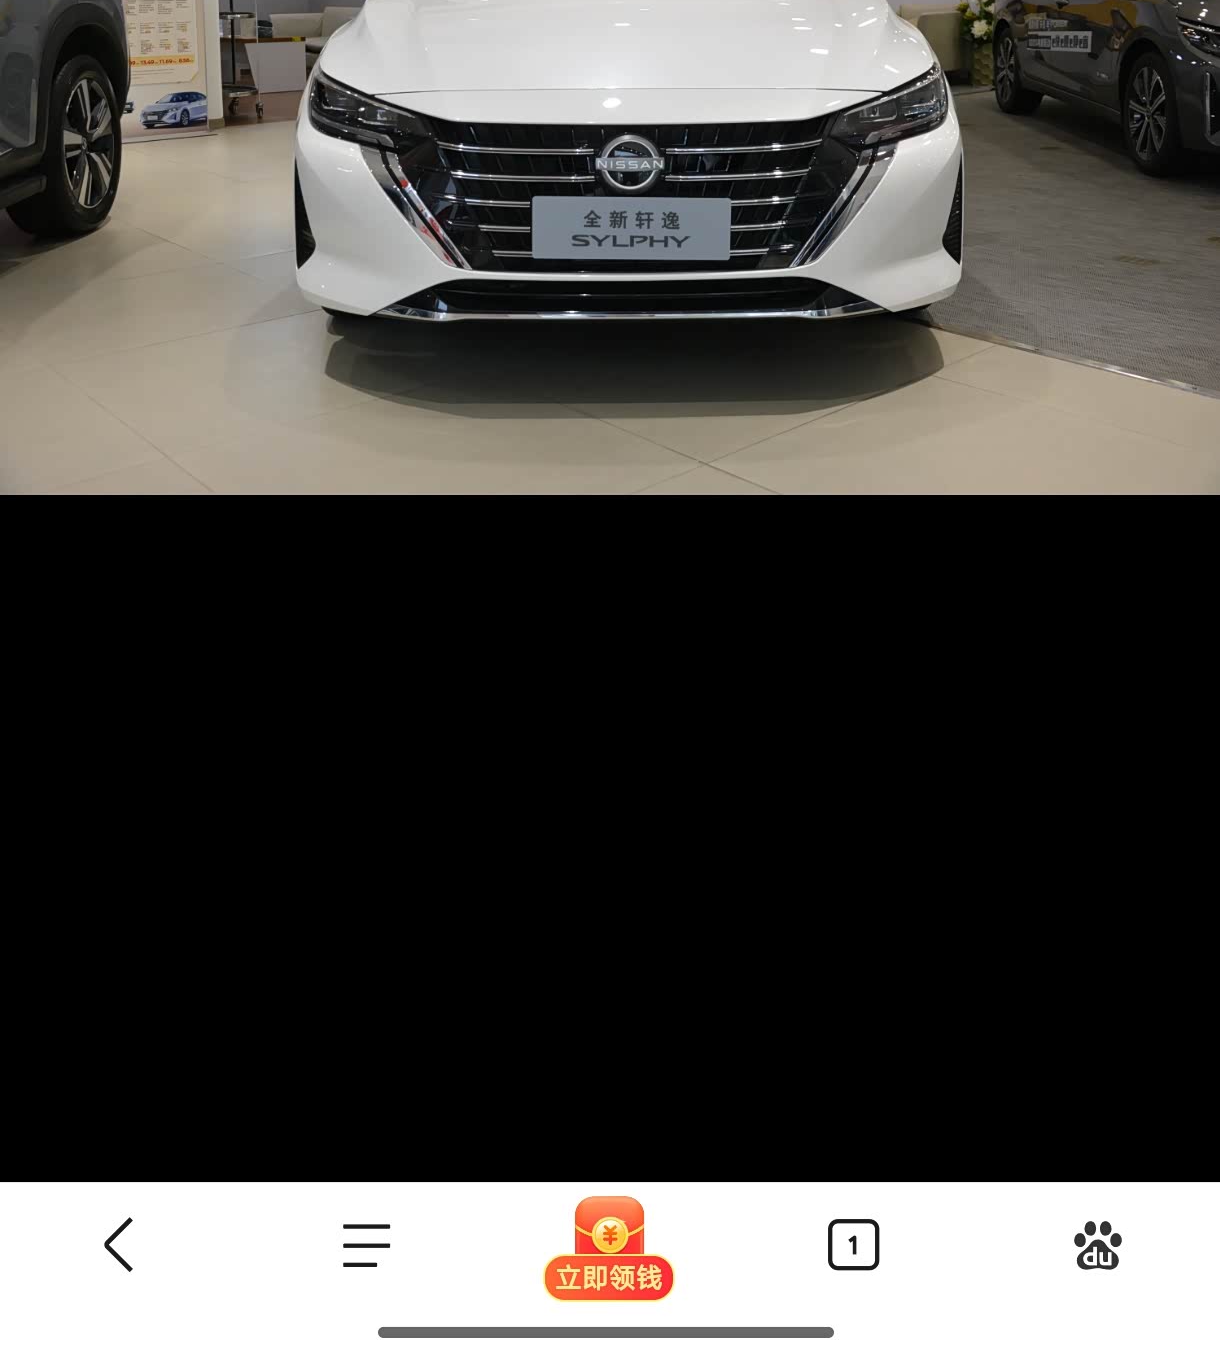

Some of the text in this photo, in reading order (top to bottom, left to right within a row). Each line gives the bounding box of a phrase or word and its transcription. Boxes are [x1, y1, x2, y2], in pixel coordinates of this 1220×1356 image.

[597, 159, 664, 169] NISSAN
[583, 209, 681, 230] 全新轩逸
[571, 234, 691, 249] SYLPHY
[847, 1234, 858, 1256] 1
[1083, 1246, 1112, 1266] du
[556, 1263, 663, 1292] 立即领钱
